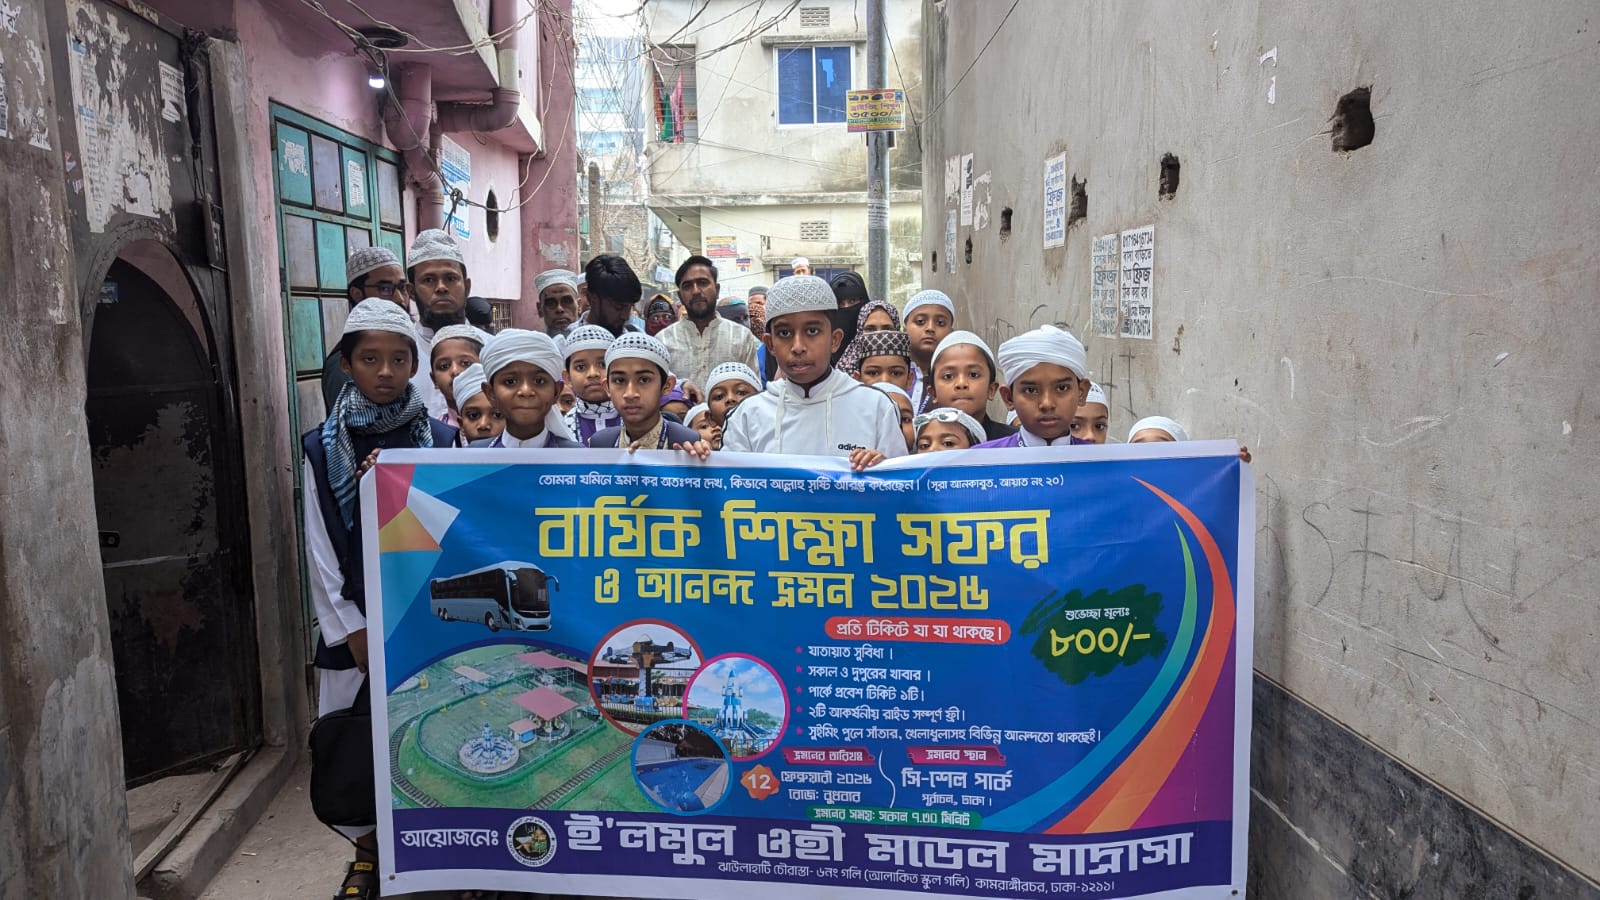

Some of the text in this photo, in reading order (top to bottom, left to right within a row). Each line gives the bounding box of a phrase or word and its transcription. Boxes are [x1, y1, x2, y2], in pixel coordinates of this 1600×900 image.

[539, 475, 576, 485] তোমরা
[579, 471, 612, 485] যমিনে
[641, 476, 658, 486] কর
[660, 477, 701, 488] অতঃপর
[730, 475, 767, 489] কিভাবে
[770, 479, 805, 492] আল্লাহ
[807, 475, 832, 493] সৃষ্টি
[999, 478, 1028, 487] আয়াত
[1030, 478, 1043, 486] নং
[535, 495, 1050, 569] বার্ষিক শিক্ষা সফর
[595, 568, 619, 603] ও
[636, 568, 755, 605] আনন্দ
[768, 571, 854, 608] ভ্রমন
[1065, 609, 1101, 620] শুভেচ্ছা
[837, 619, 862, 635] প্রতি
[866, 619, 909, 637] টিকিটে
[913, 625, 929, 637] যা
[933, 625, 948, 637] যা
[1050, 623, 1150, 656] ৮০০/-
[808, 646, 851, 658] যাতায়াত
[853, 644, 884, 662] সুবিধা
[808, 666, 838, 677] সকাল
[840, 667, 848, 678] ও
[852, 668, 887, 682] দুপুরের
[890, 669, 921, 680] খাবার
[809, 684, 832, 697] পার্কে
[835, 688, 863, 698] প্রবেশ
[866, 684, 896, 700] টিকিট
[809, 703, 826, 718] ২টি
[882, 707, 909, 721] রাইড
[912, 708, 943, 722] সম্পূর্ণ
[808, 723, 839, 740] সুইমিং
[842, 728, 864, 741] পুলে
[905, 729, 966, 742] খেলাধুলাসহ
[969, 726, 1001, 744] বিভিন্ন
[748, 774, 770, 789] 12
[901, 768, 1012, 791] সি-শেল পার্ক
[823, 790, 861, 804] বুধবার
[962, 795, 985, 805] ঢাকা
[879, 811, 908, 822] সকাল
[941, 811, 970, 825] মিনিট
[758, 824, 845, 863] ওহী
[865, 834, 1009, 876] মডেল
[1029, 831, 1193, 875] মাদ্রাসা
[841, 866, 861, 879] গলি
[920, 875, 942, 889] স্কুল
